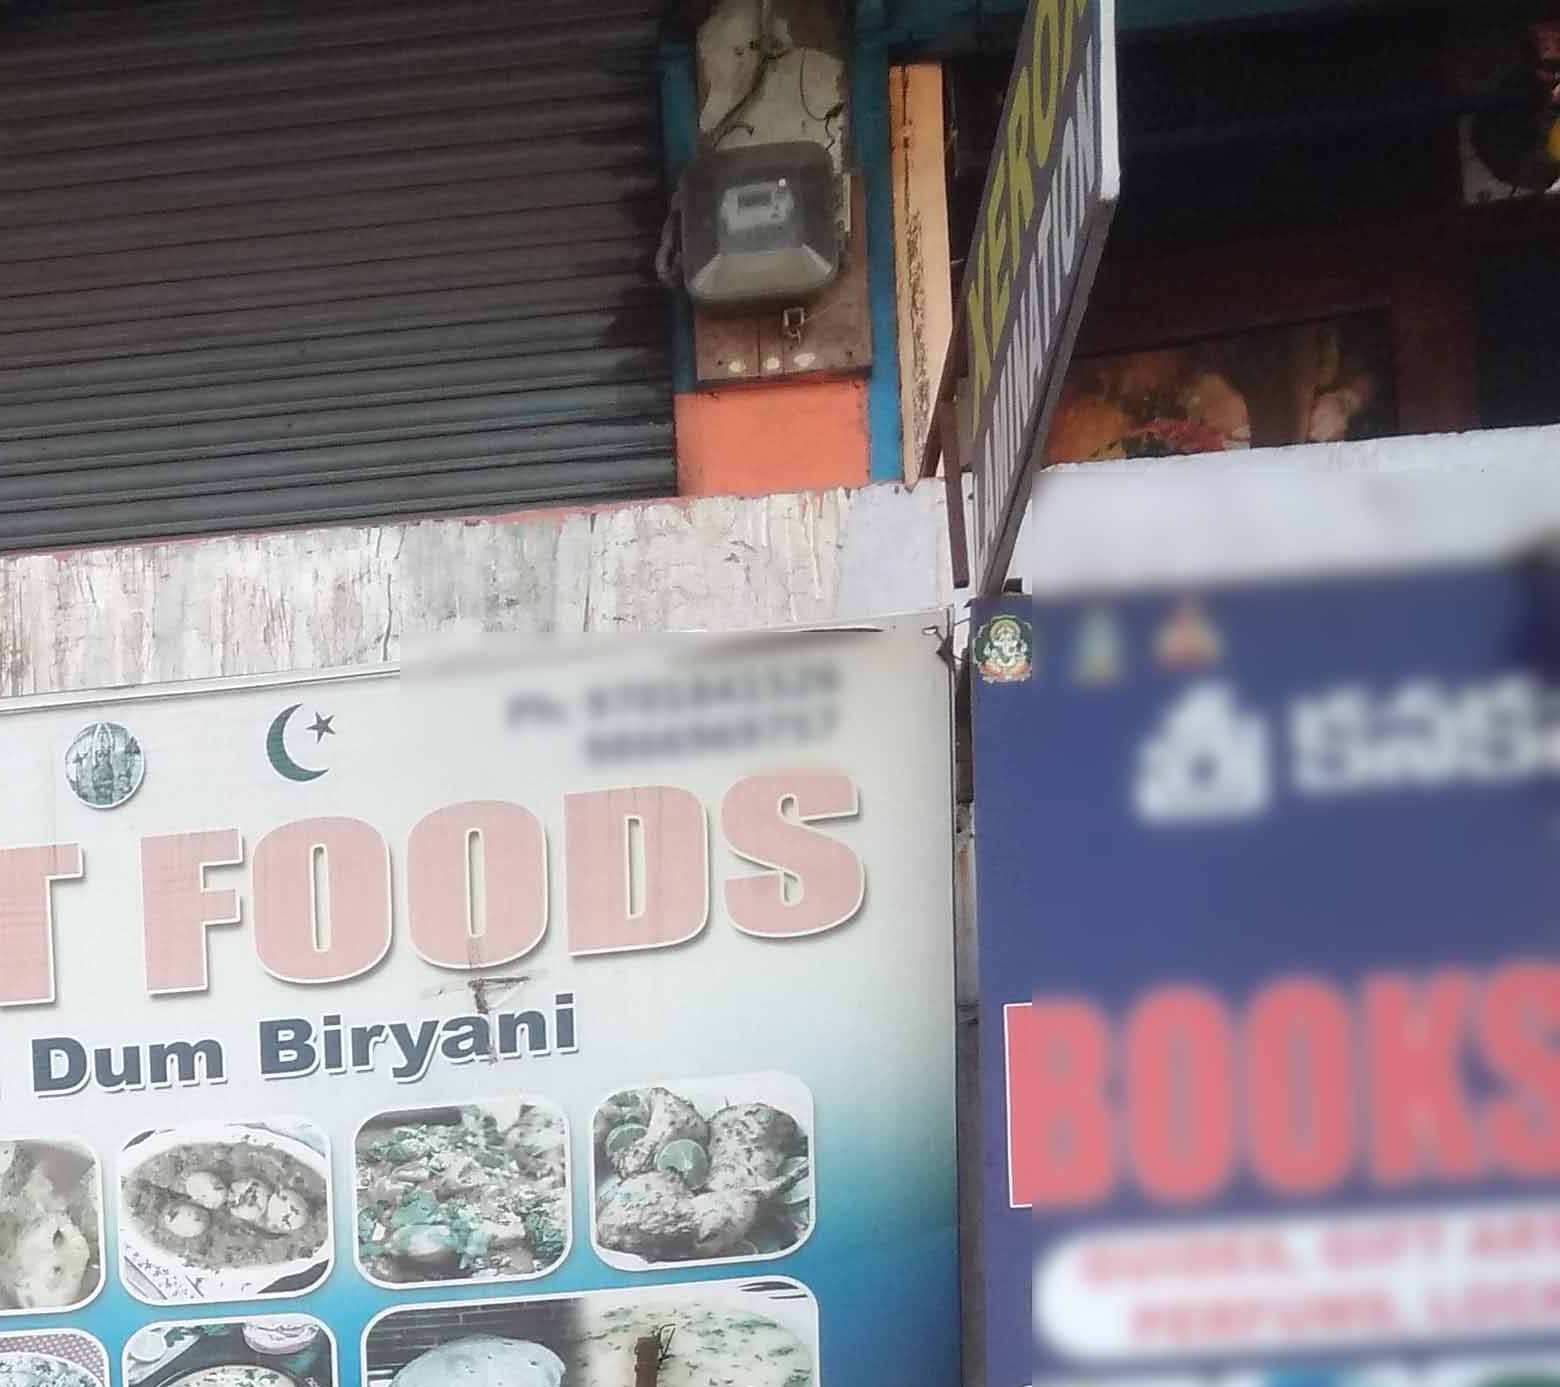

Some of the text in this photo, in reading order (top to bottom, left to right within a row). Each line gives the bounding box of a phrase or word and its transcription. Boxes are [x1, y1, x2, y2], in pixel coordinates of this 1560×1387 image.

[139, 768, 866, 998] FOODS
[32, 1034, 225, 1098] Dum
[259, 995, 578, 1085] Biryani
